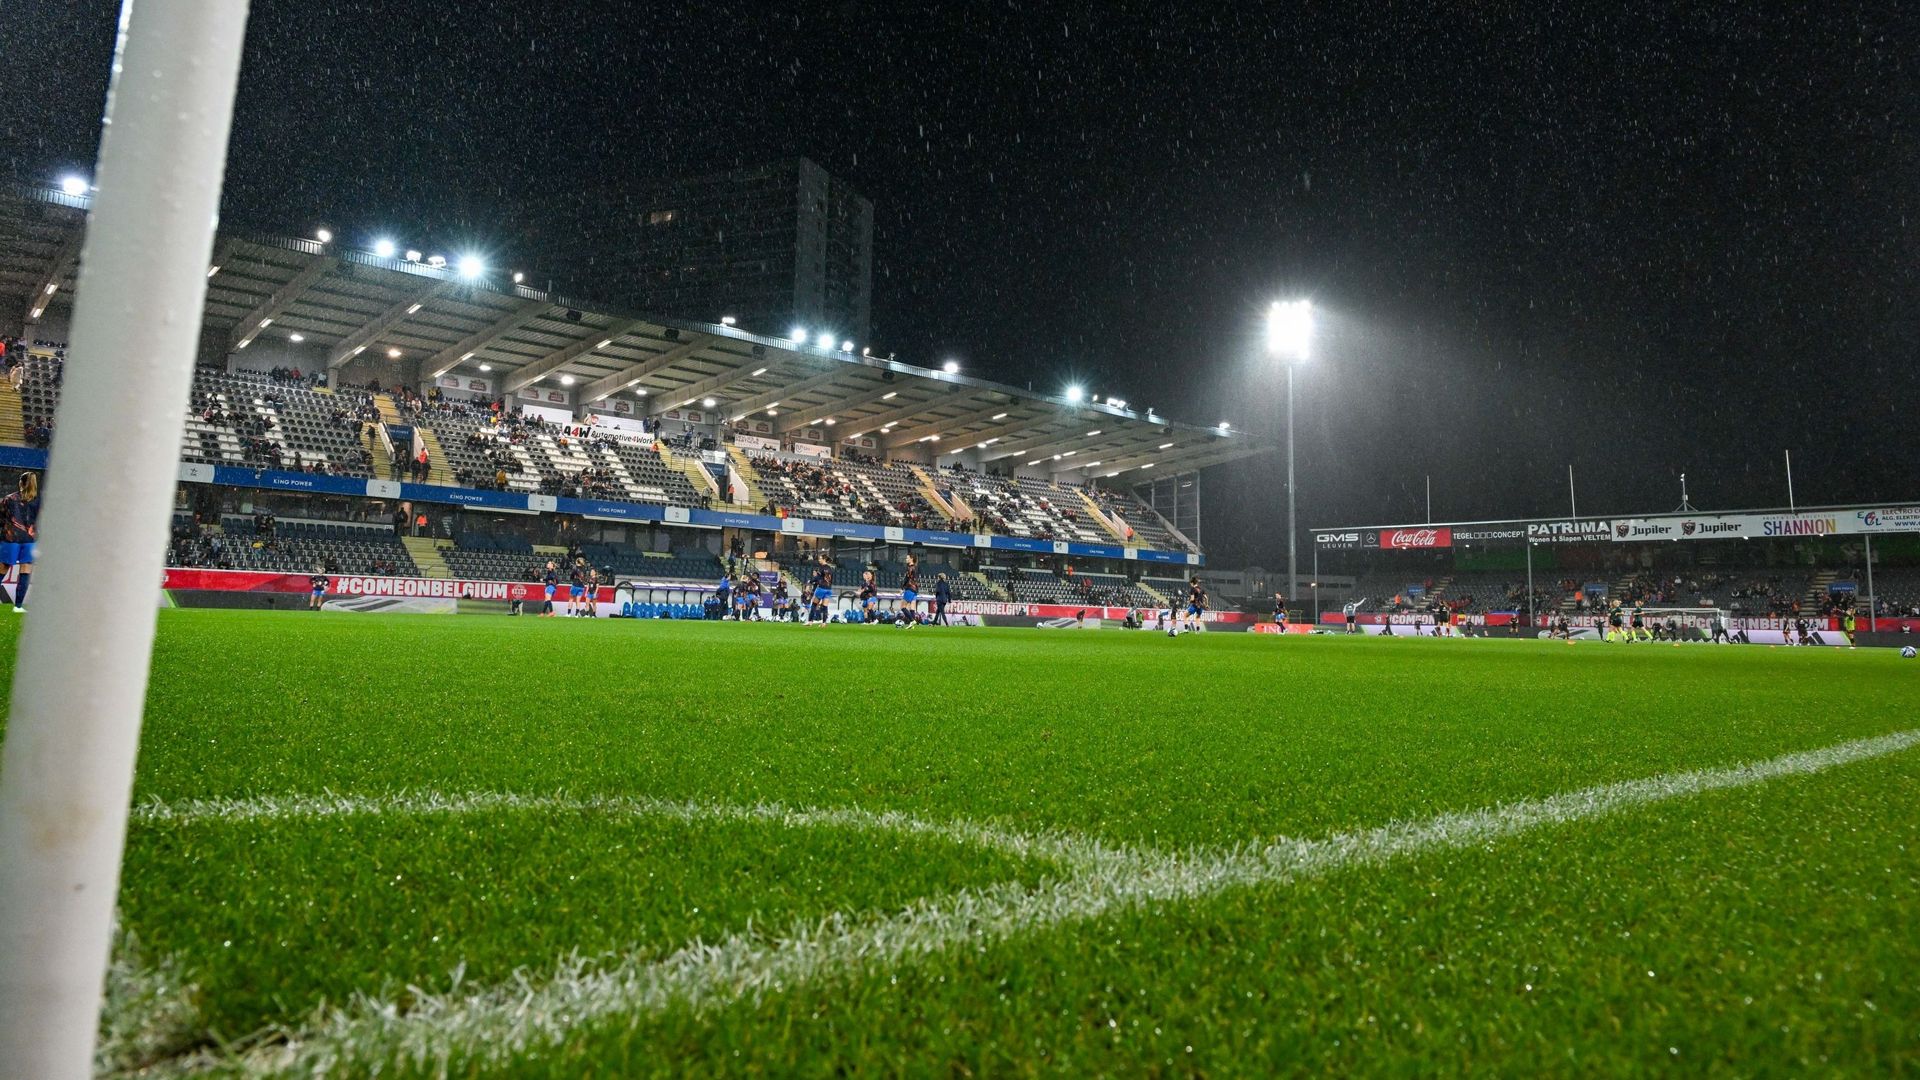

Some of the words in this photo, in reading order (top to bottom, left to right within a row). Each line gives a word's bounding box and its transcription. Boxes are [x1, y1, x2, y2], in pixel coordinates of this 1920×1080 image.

[564, 425, 592, 438] A4W
[591, 431, 654, 444] Automotive4Work
[1528, 521, 1611, 535] PATRIMA
[1632, 525, 1672, 536] Jupiler
[1698, 523, 1742, 534] Jupiler
[1763, 518, 1836, 536] SHANNON
[1316, 533, 1359, 543] GMS
[1453, 532, 1474, 540] TEGEL
[1492, 531, 1525, 539] CONCEPT
[1559, 535, 1582, 543] Slapen
[337, 577, 508, 598] #COMEONBELGIUM
